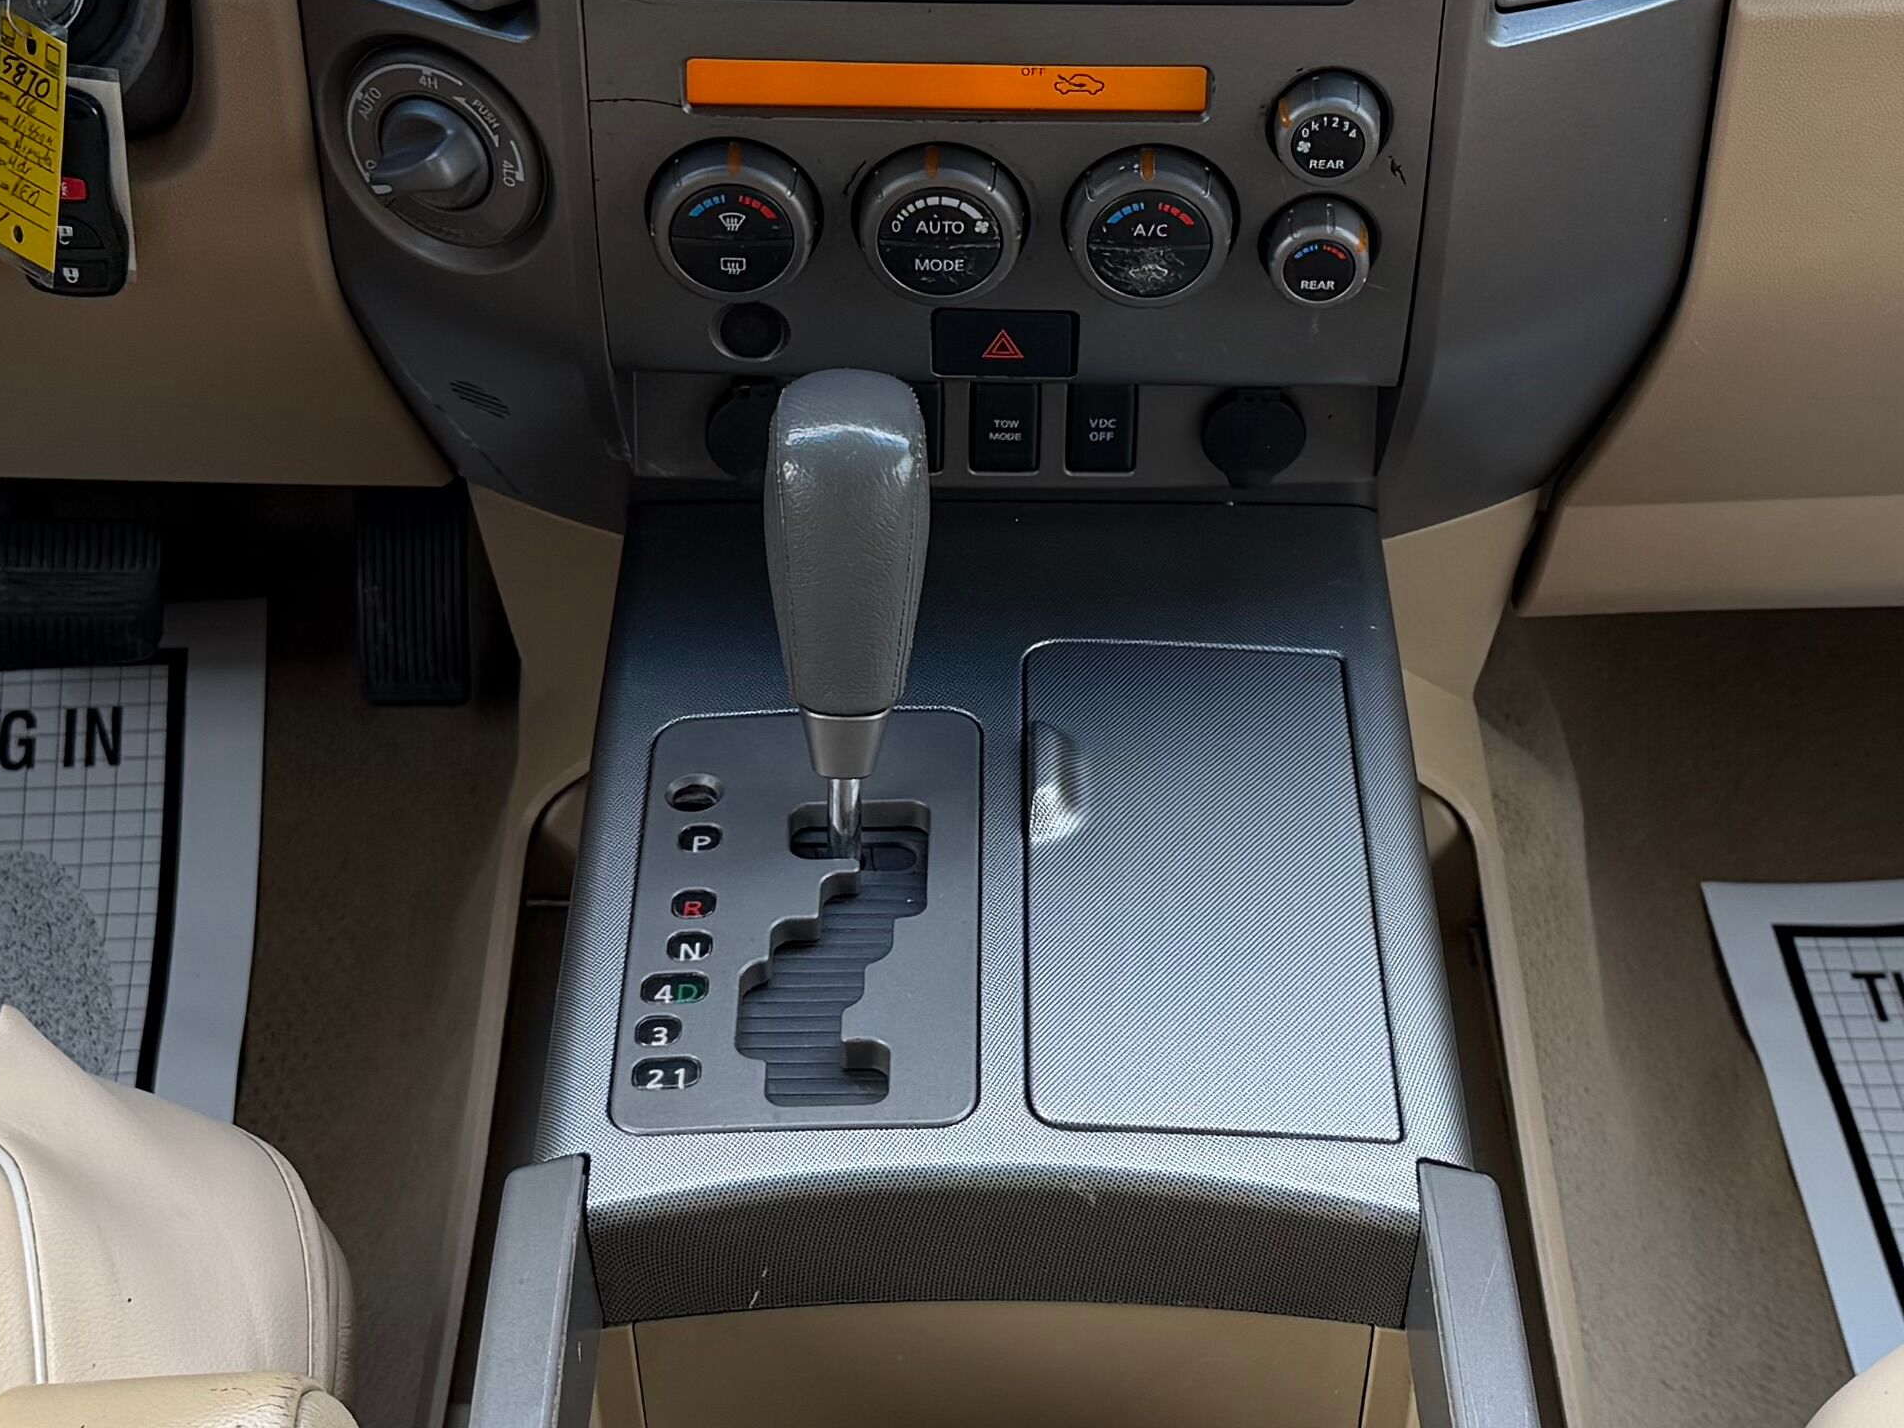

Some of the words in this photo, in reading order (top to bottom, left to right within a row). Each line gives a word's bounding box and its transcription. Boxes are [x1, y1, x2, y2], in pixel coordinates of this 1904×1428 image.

[357, 87, 382, 121] AUTO
[471, 99, 501, 130] PUSH
[1309, 158, 1345, 170] REAR
[915, 220, 965, 235] AUTO
[1133, 223, 1168, 238] A/C
[914, 258, 965, 272] MODE
[1300, 279, 1336, 291] REAR
[993, 419, 1020, 429] TOW
[1089, 418, 1117, 429] VDC
[989, 431, 1022, 442] MODE
[1088, 431, 1115, 443] OFF
[63, 705, 124, 767] IN
[692, 835, 712, 853] P
[683, 900, 702, 917] R
[679, 942, 702, 961] N
[651, 1026, 669, 1046] 3
